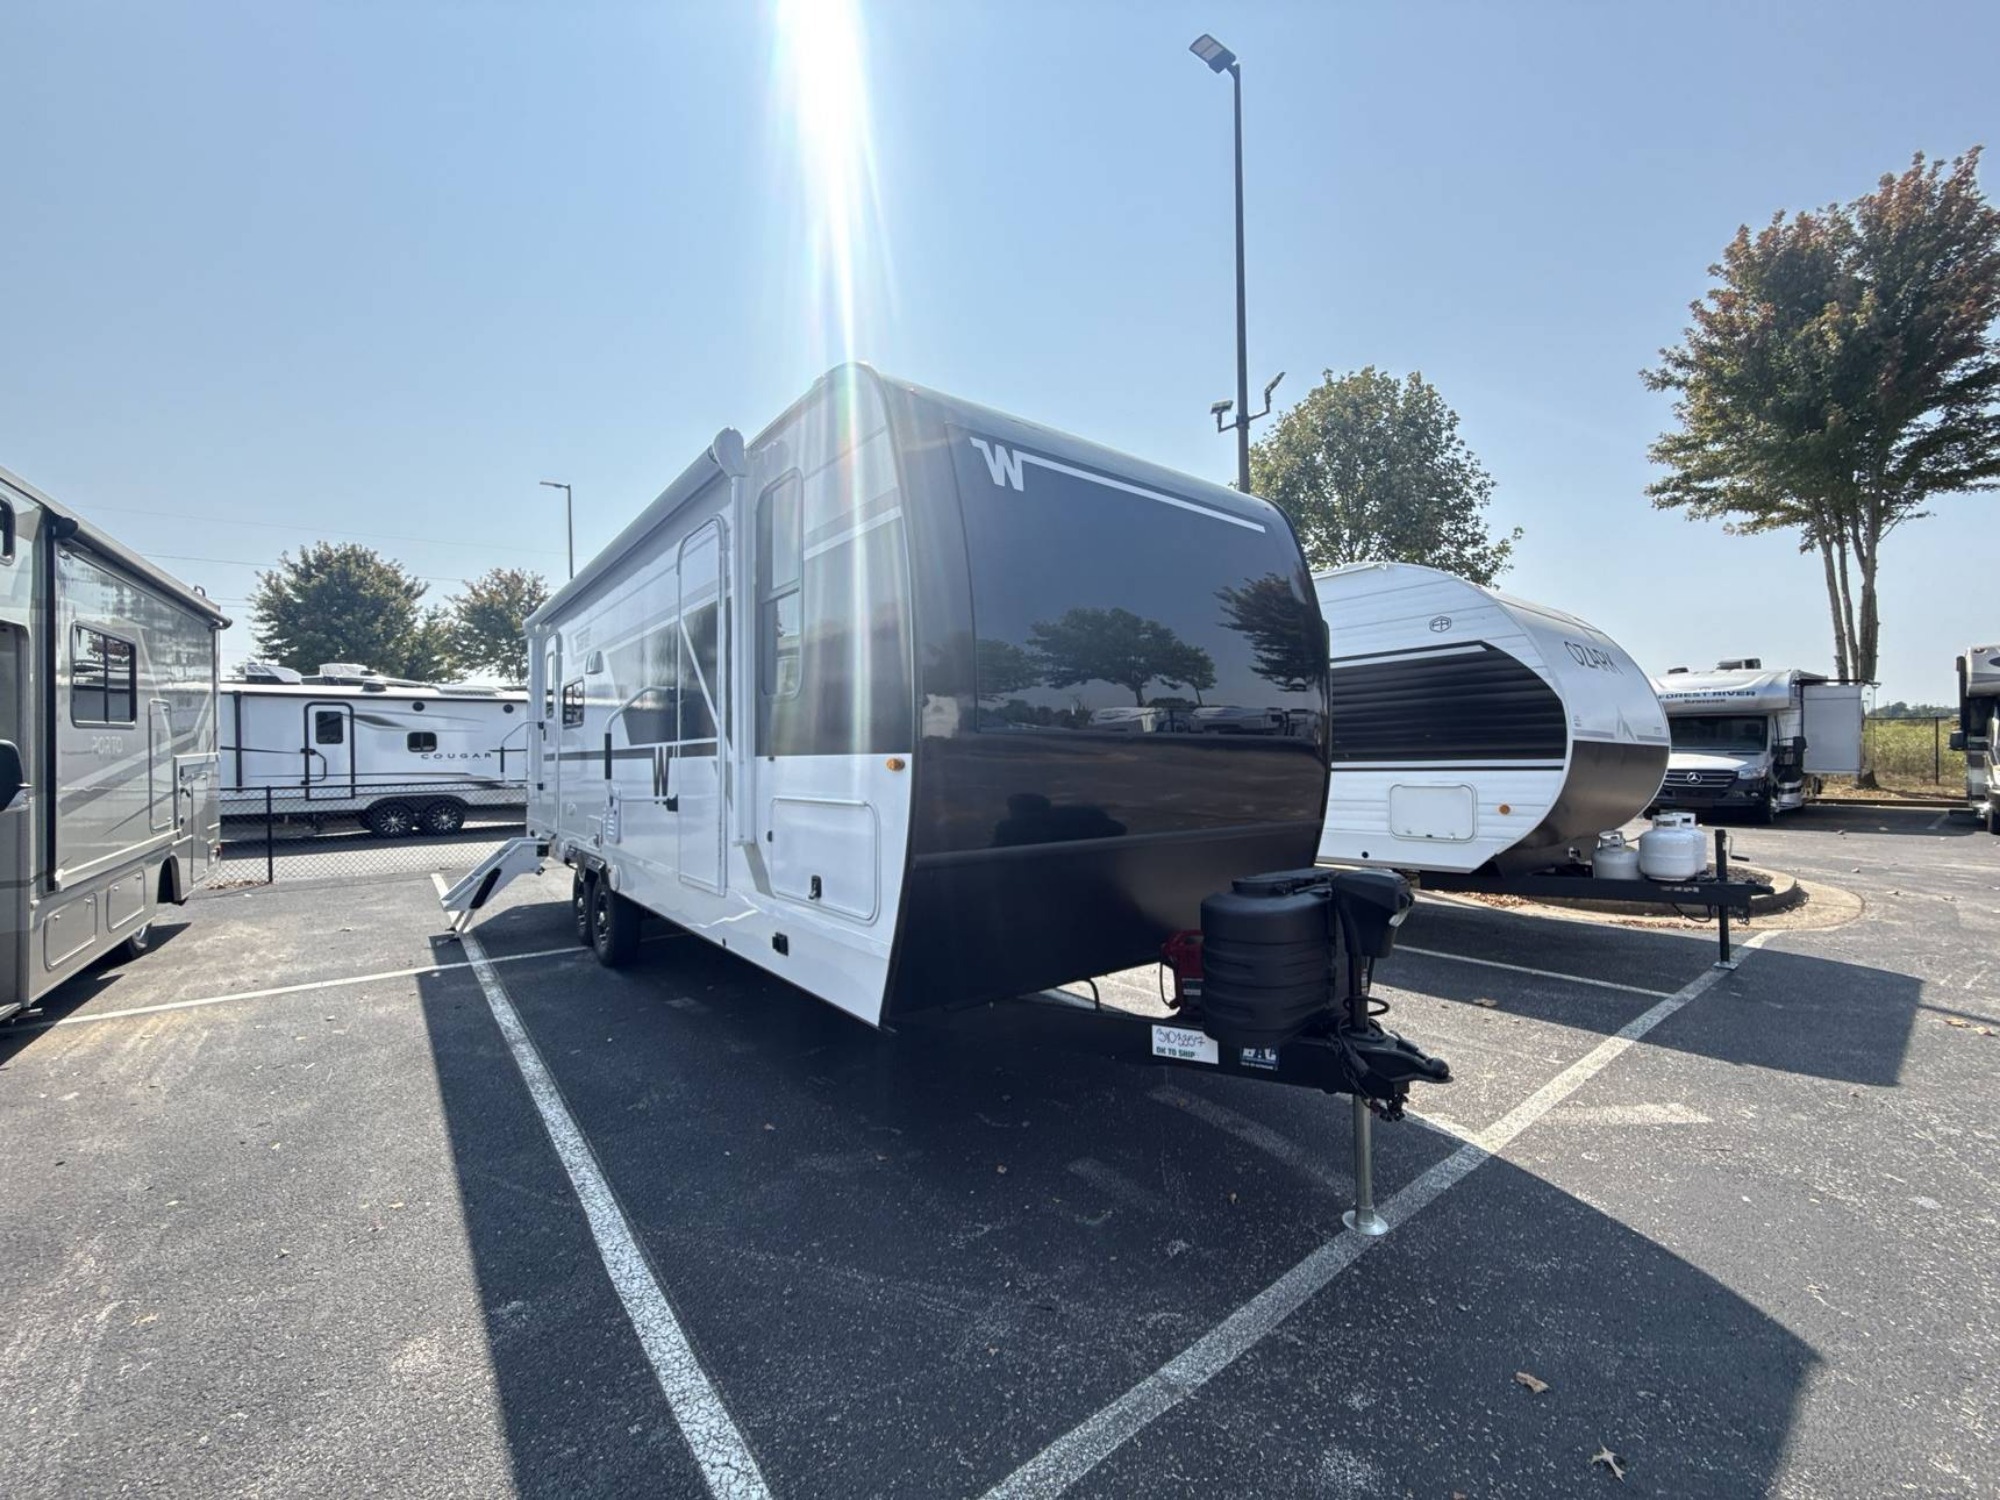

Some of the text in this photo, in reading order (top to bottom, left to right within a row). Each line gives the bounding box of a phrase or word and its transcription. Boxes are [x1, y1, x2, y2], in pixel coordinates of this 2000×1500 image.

[969, 436, 1025, 492] W
[1563, 641, 1625, 677] OZARK
[1658, 690, 1756, 700] FOREST RIVER
[421, 752, 492, 760] COUGAR
[1156, 1046, 1196, 1059] OK TO SHIP
